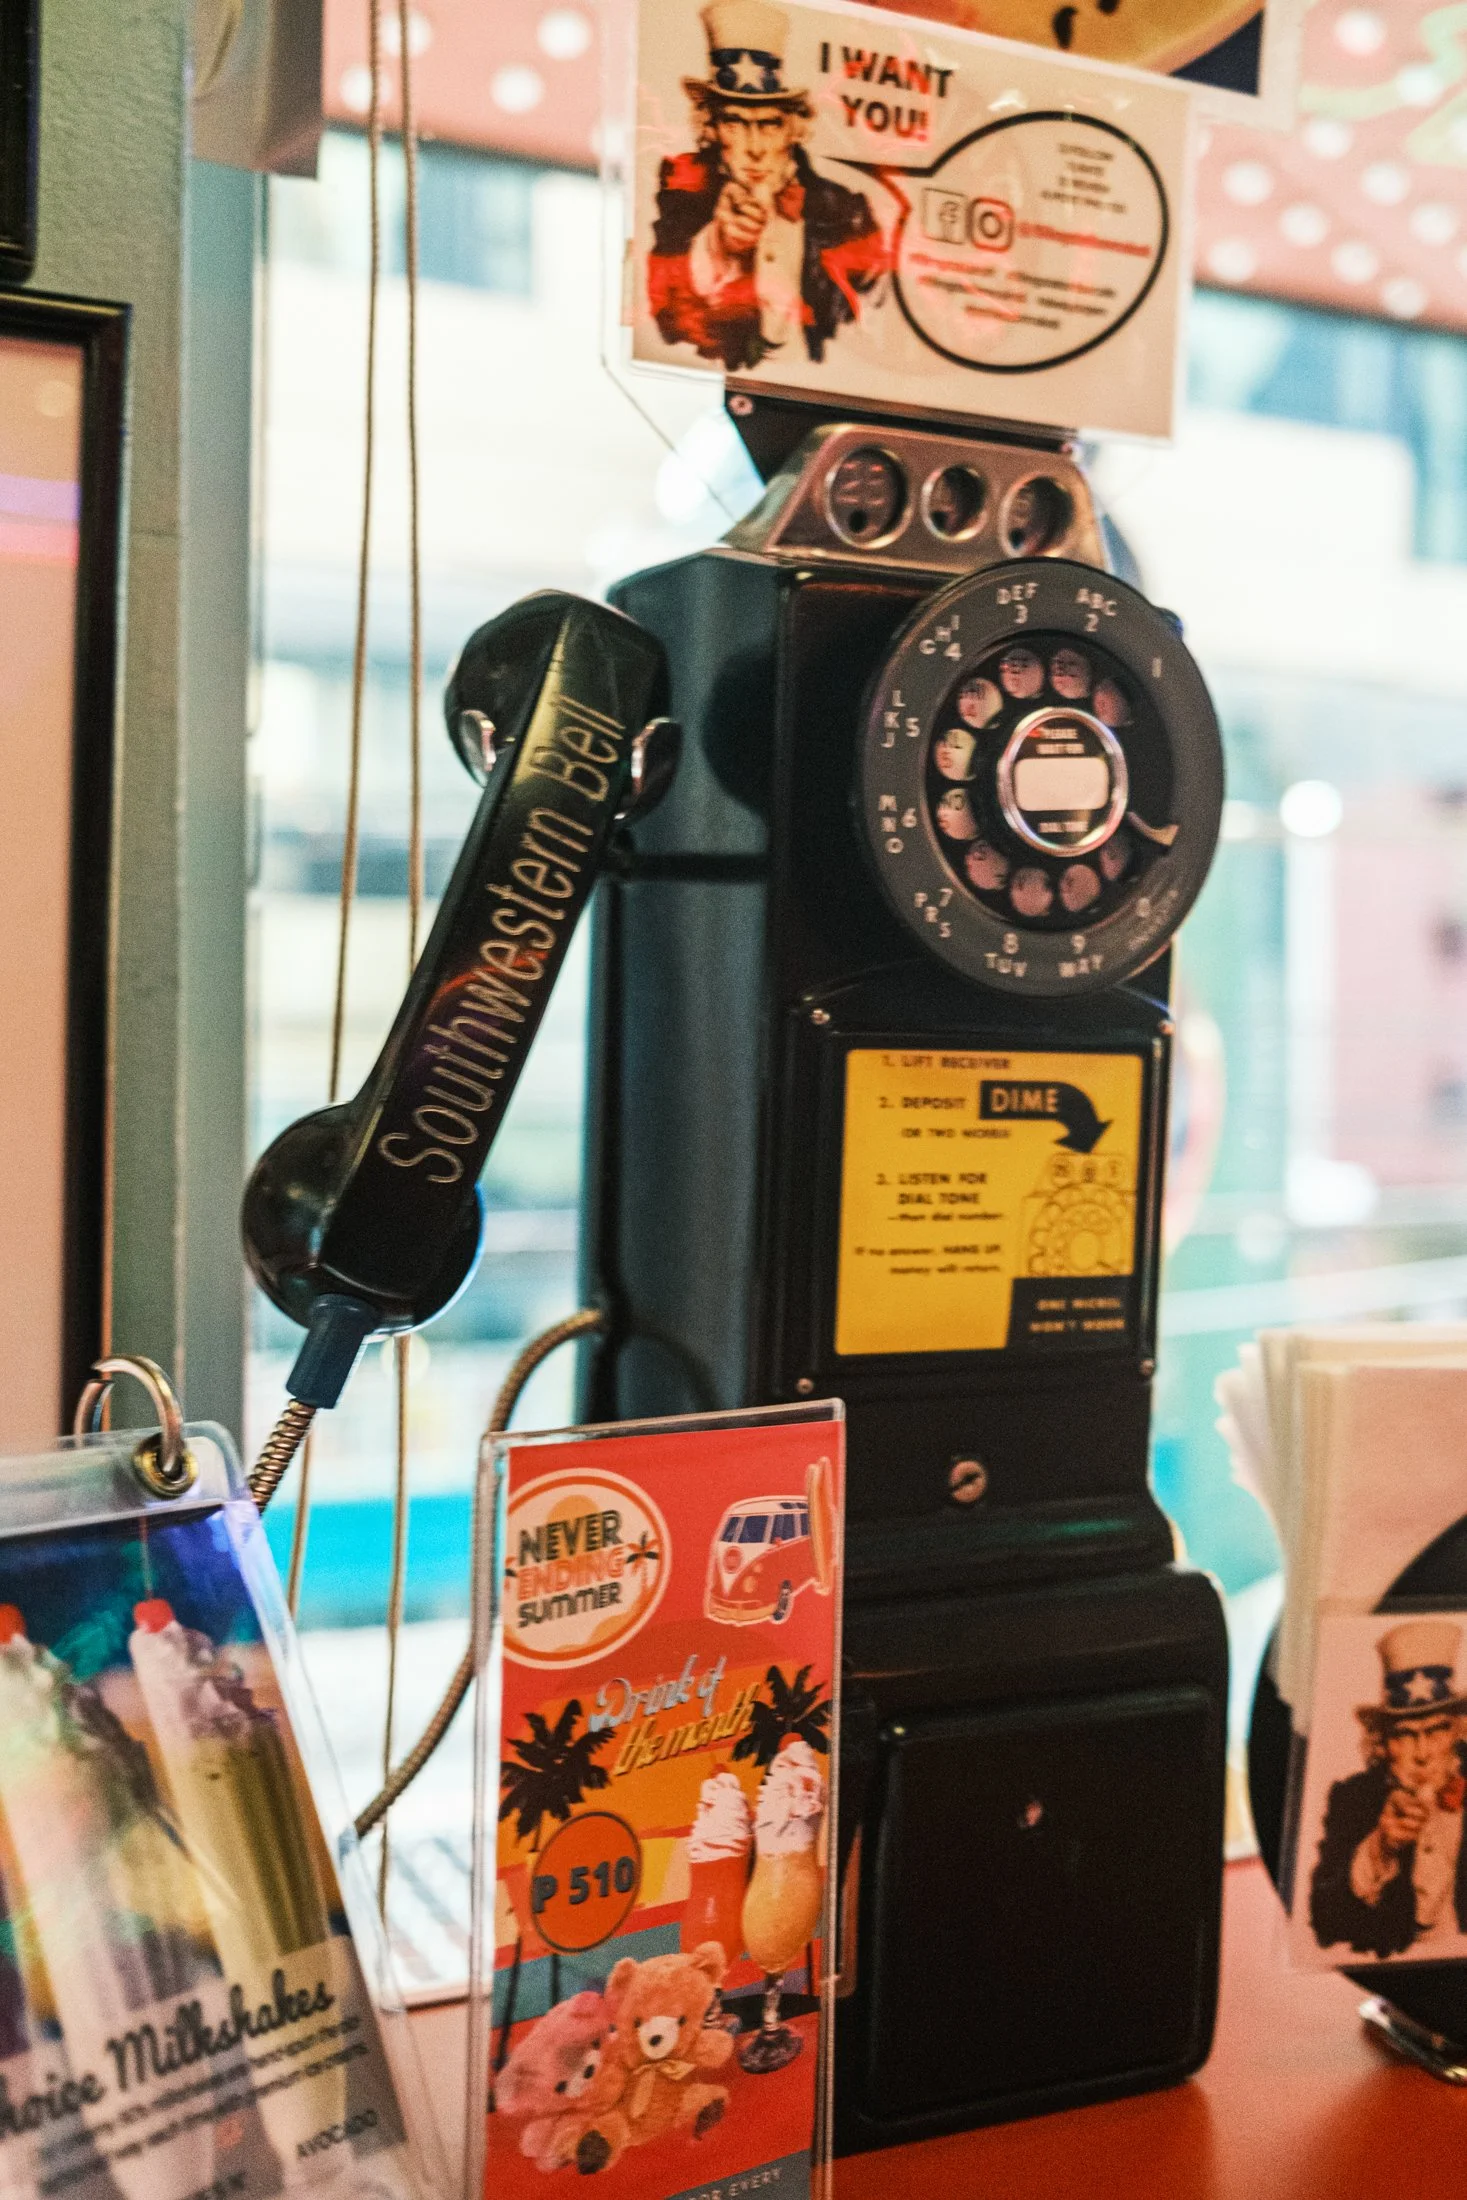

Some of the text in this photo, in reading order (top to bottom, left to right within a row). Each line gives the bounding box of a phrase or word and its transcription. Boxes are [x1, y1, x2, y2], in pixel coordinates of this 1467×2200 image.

[820, 42, 954, 98] I WANT
[841, 95, 928, 141] YOU!
[1014, 604, 1028, 624] 3
[1084, 613, 1099, 632] 2
[944, 643, 962, 661] 4
[905, 717, 920, 738] 5
[902, 807, 917, 828] 6
[939, 888, 953, 907] 7
[378, 692, 627, 1184] Southwestern Bell
[1003, 932, 1019, 954] 8
[1072, 934, 1086, 954] 9
[902, 1097, 966, 1109] DEPOSIT
[989, 1087, 1059, 1113] DIME
[898, 1173, 950, 1185] LISTEN
[519, 1510, 622, 1566] NEVER
[518, 1546, 624, 1601] ENDING
[518, 1582, 622, 1628] SUMMER
[588, 1654, 727, 1731] Drink of
[613, 1681, 760, 1776] the month
[532, 1855, 635, 1914] P 510
[105, 1968, 335, 2089] Milkshakes
